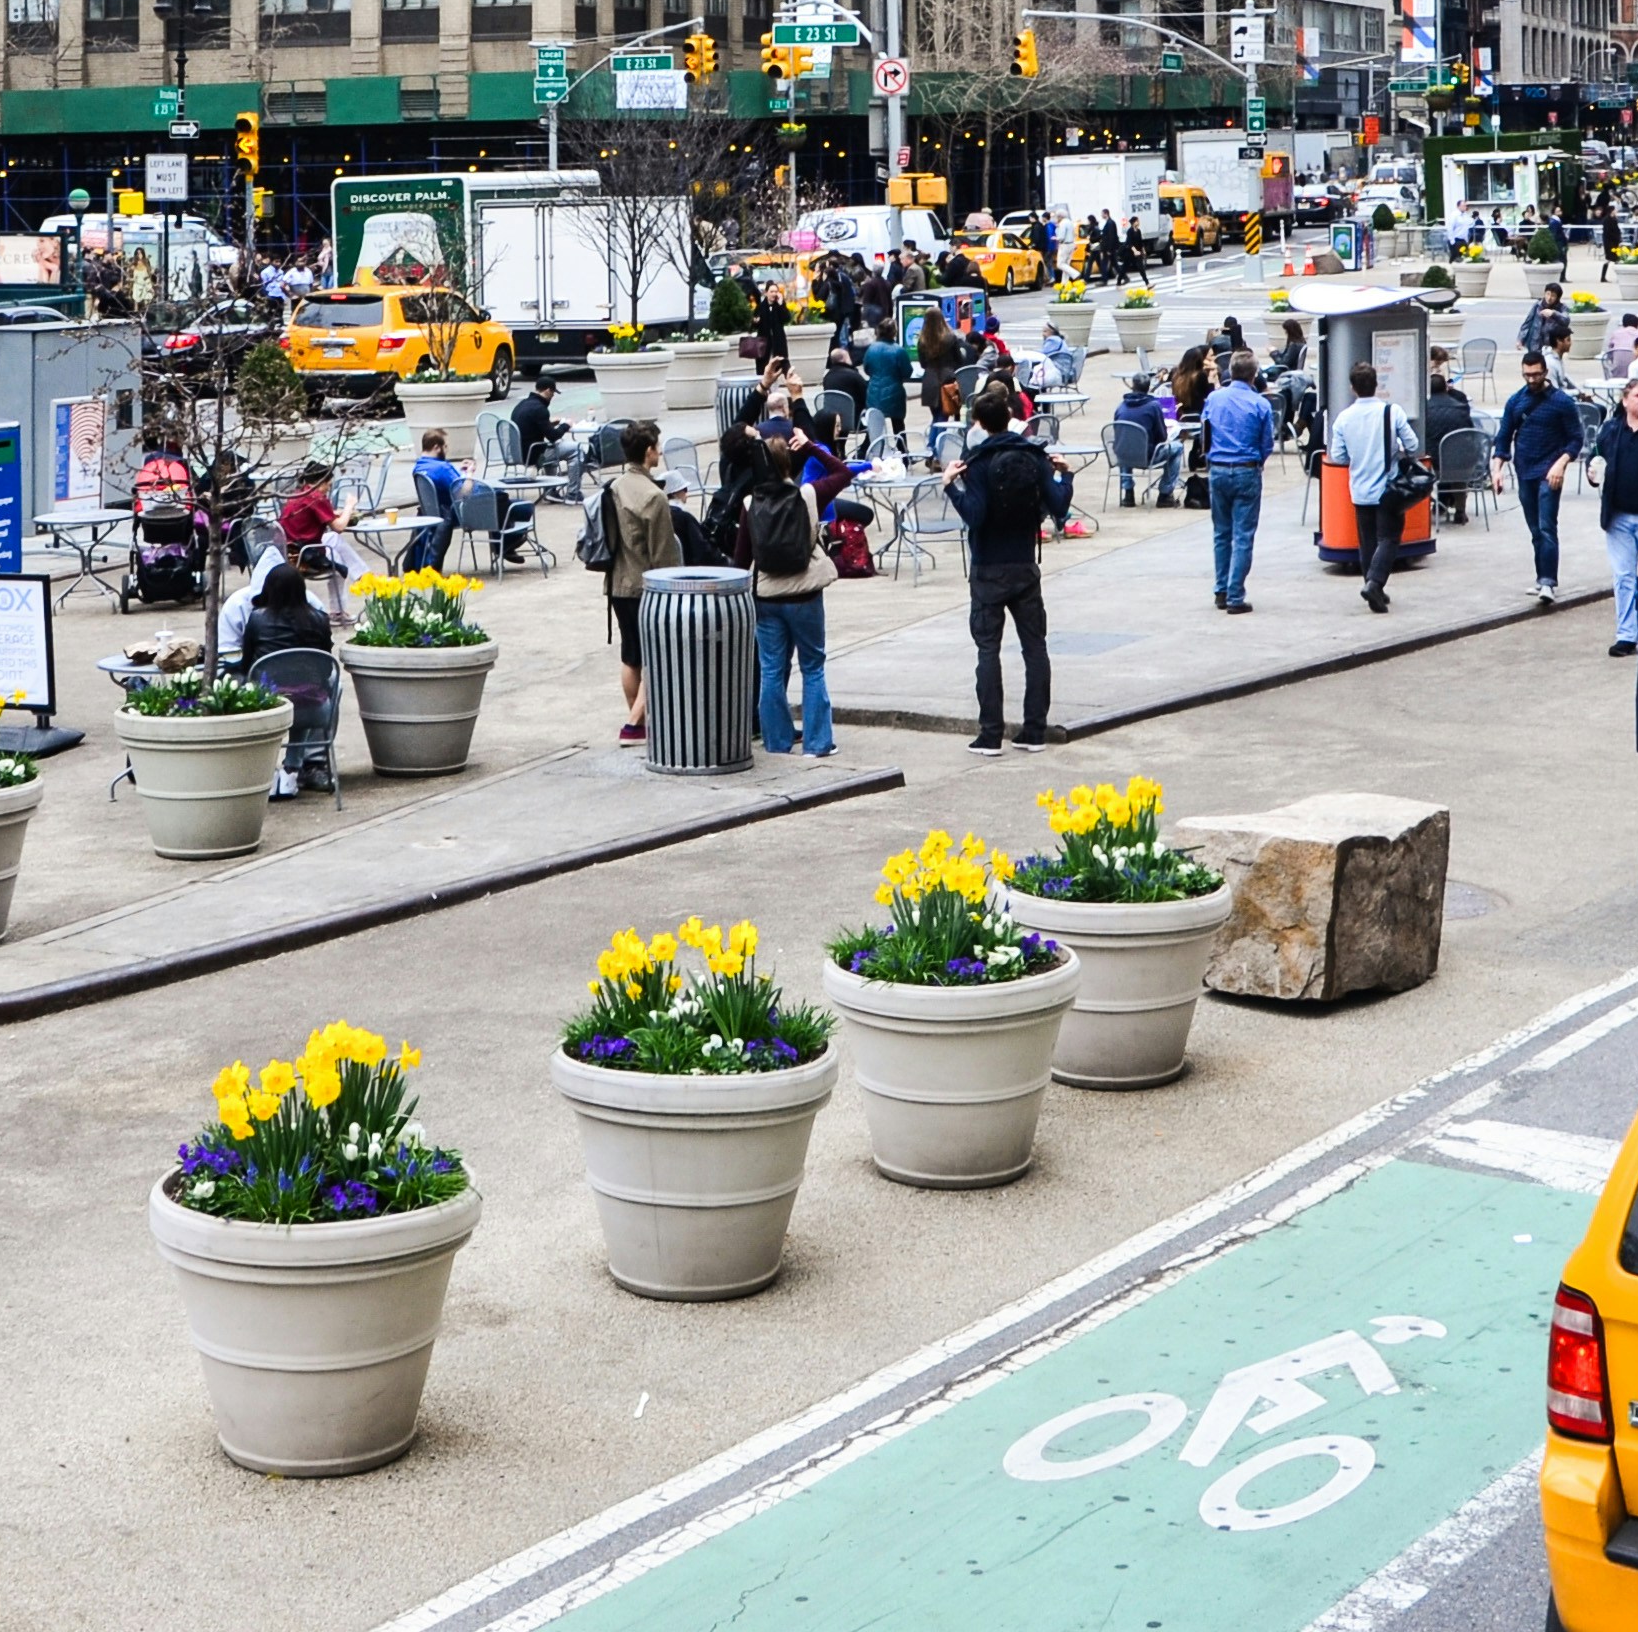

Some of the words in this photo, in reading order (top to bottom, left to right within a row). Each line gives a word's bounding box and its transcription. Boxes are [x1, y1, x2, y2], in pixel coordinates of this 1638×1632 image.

[794, 28, 802, 41] E
[806, 27, 820, 41] 23
[824, 27, 837, 41] St
[626, 59, 632, 70] E
[635, 58, 645, 69] 23
[647, 58, 657, 69] St
[149, 160, 164, 168] LEFT
[167, 160, 183, 168] LANE
[156, 173, 177, 182] MUST
[150, 186, 165, 195] TURN
[168, 186, 183, 195] LEFT
[350, 192, 412, 204] DISCOVER
[415, 191, 451, 201] PALM.
[18, 658, 38, 669] THIS
